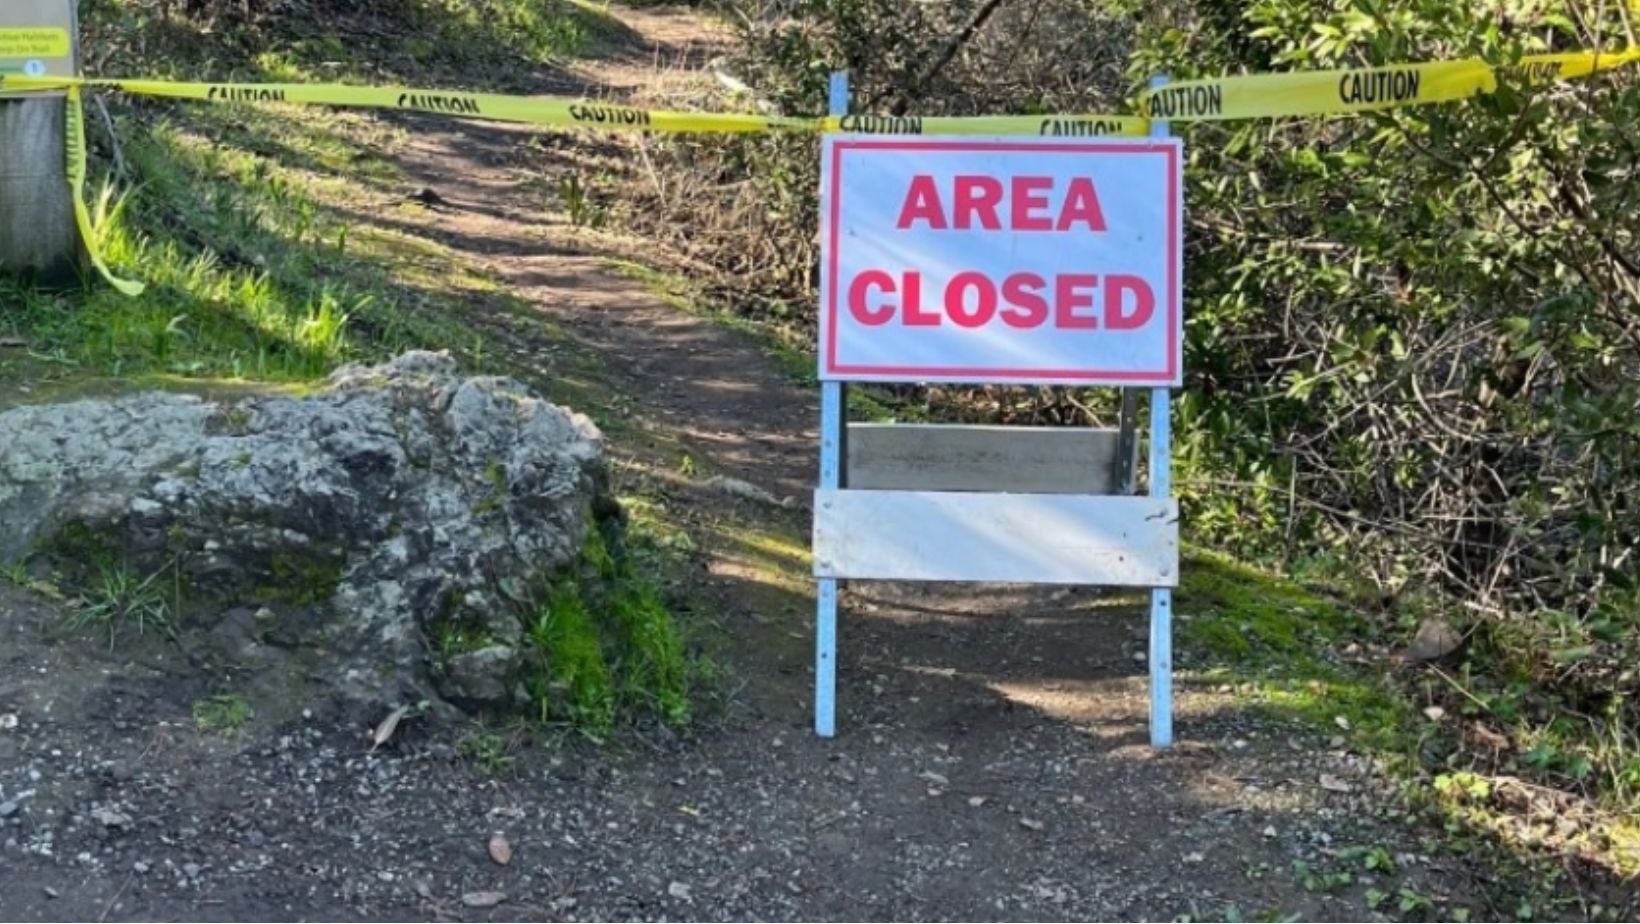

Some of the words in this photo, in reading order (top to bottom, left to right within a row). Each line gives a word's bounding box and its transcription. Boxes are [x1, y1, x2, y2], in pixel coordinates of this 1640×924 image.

[398, 93, 480, 113] CAUTION
[568, 104, 650, 125] CAUTION
[1147, 84, 1222, 117] AUTION
[1338, 69, 1420, 103] CAUTION
[839, 114, 922, 134] CAUTION
[896, 175, 1107, 231] AREA
[847, 269, 1155, 330] CLOSED
